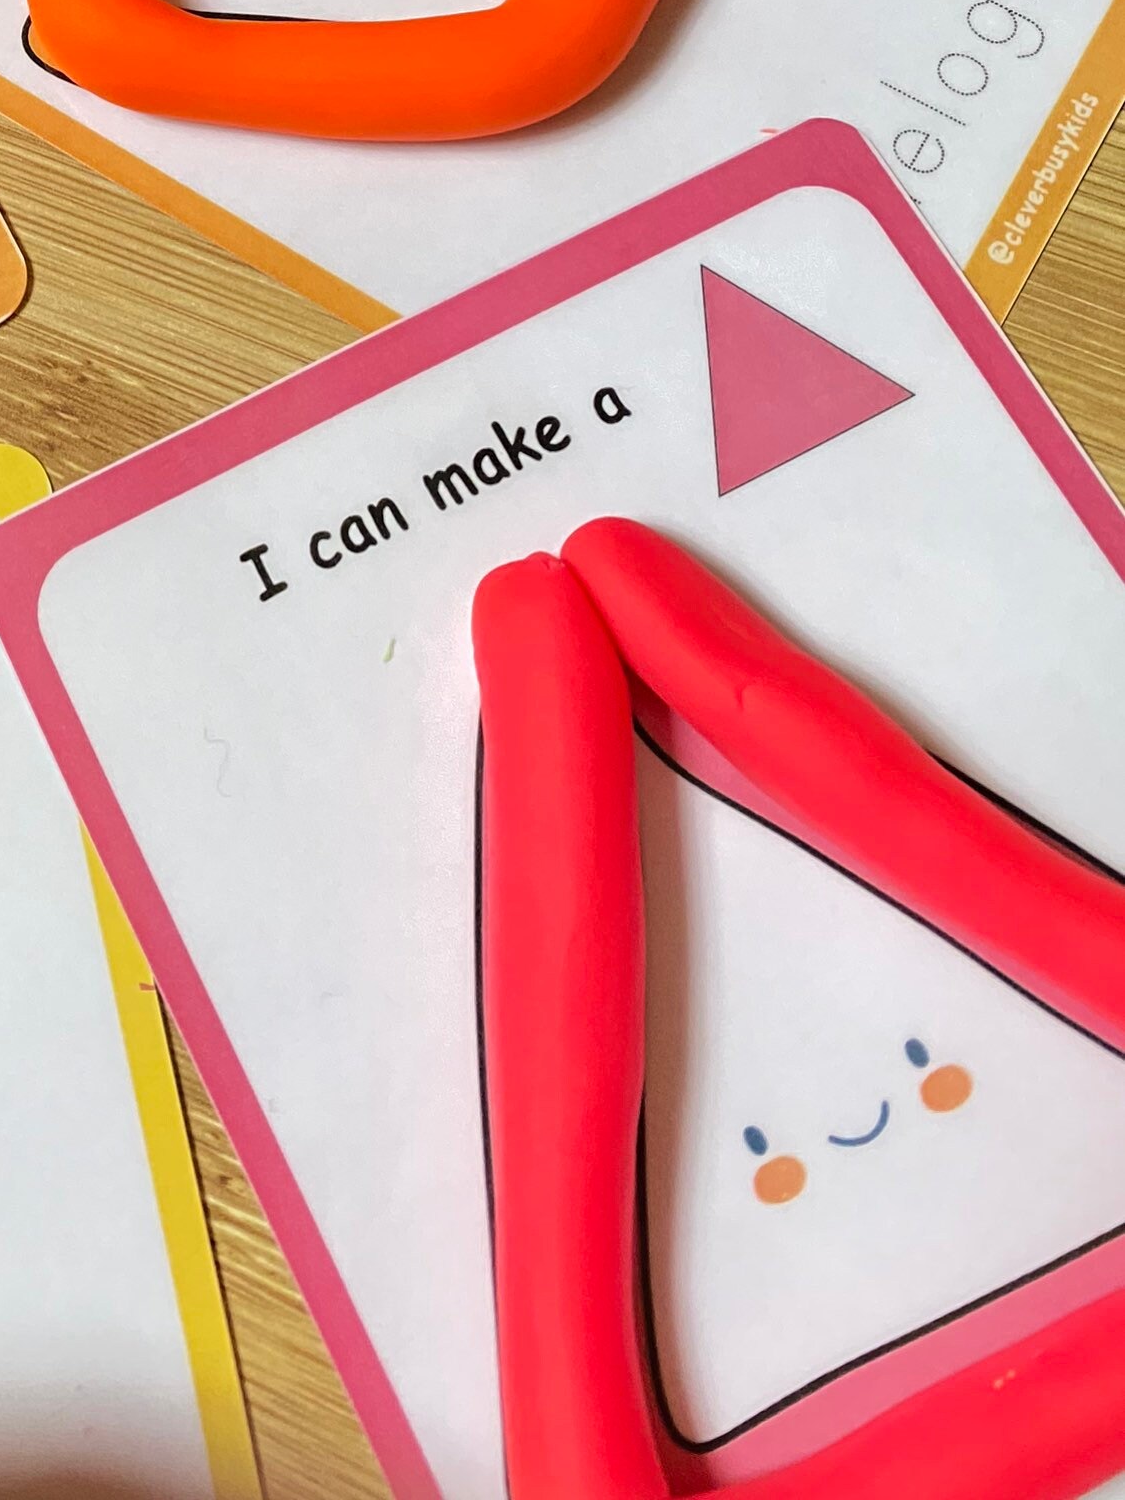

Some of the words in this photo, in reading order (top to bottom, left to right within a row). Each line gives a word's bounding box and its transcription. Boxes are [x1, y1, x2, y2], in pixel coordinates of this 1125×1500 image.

[987, 91, 1099, 265] @cleverbusykids
[239, 543, 289, 602] I
[308, 497, 410, 569] can
[422, 415, 573, 511] make
[593, 387, 633, 425] a
